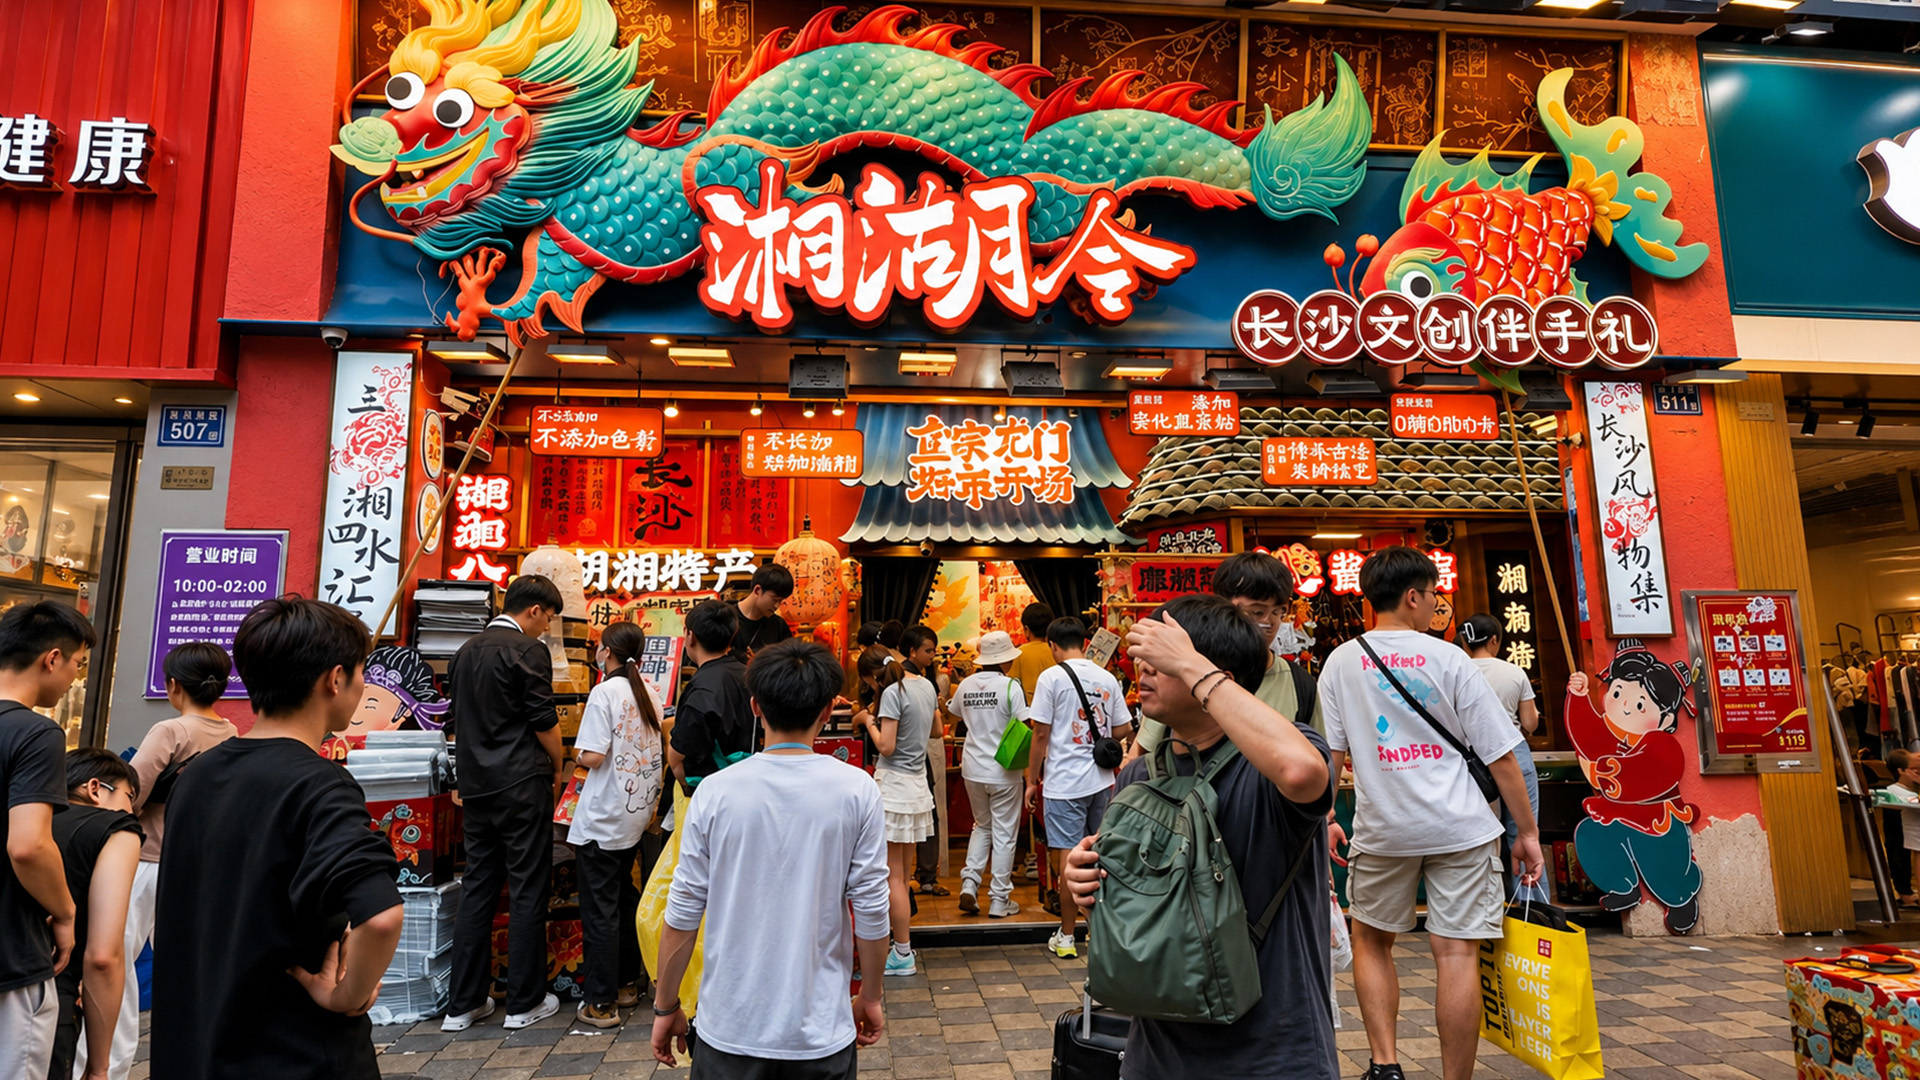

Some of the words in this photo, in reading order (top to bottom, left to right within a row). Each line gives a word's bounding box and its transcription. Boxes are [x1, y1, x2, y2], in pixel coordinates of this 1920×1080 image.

[0, 113, 151, 187] 健康
[1241, 303, 1652, 353] 长沙文创伴手礼
[171, 422, 208, 440] 507
[325, 384, 400, 620] 三湘四水汇
[1596, 413, 1664, 615] 长沙风物集
[186, 547, 257, 565] 营业时间
[173, 579, 268, 593] 10:00-02:00
